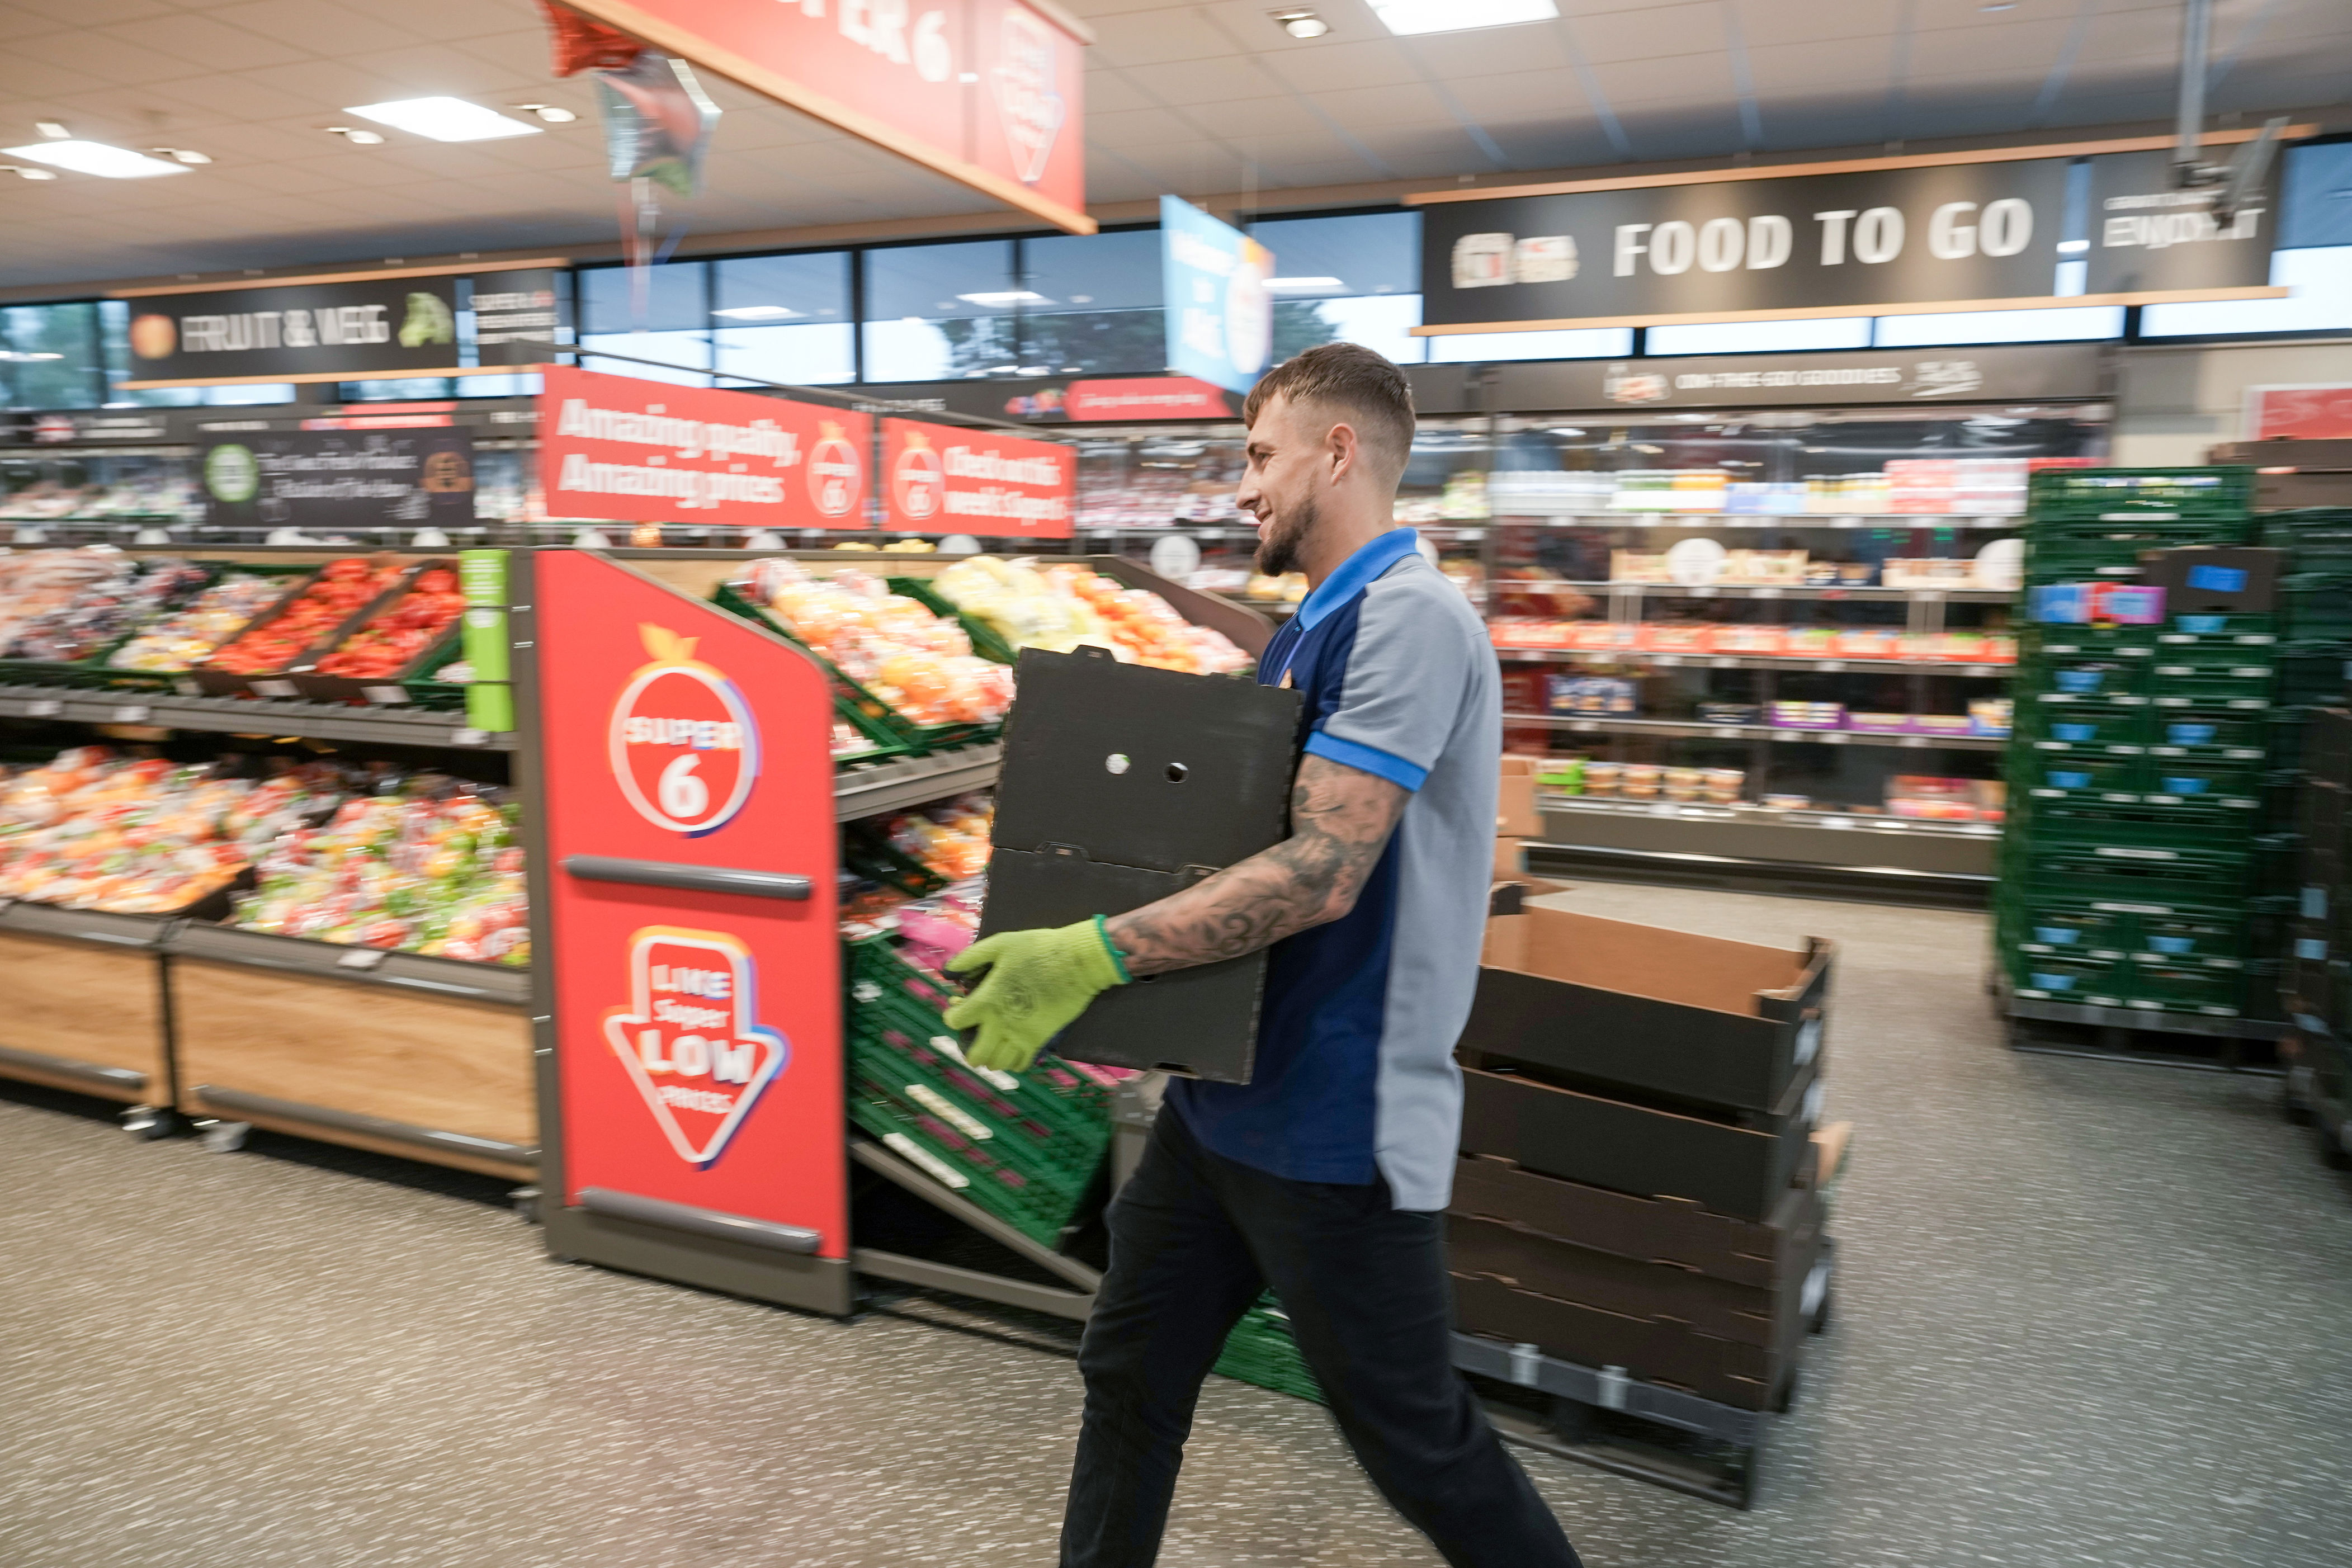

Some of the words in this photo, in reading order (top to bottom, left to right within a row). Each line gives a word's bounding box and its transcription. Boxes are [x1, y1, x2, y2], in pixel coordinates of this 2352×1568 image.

[911, 10, 952, 82] 6
[1613, 215, 1793, 277] FOOD
[1813, 206, 1906, 266] TO
[1928, 198, 2034, 260] GO
[181, 311, 281, 352] FRUIT
[282, 309, 318, 347] &
[314, 305, 390, 345] VEG
[556, 399, 705, 459] Amazing
[558, 454, 706, 509] Amazing
[701, 463, 785, 509] prices
[623, 716, 745, 751] SUPER
[658, 753, 709, 818] 6
[650, 964, 732, 999] LIKE
[639, 1029, 756, 1084] LOW
